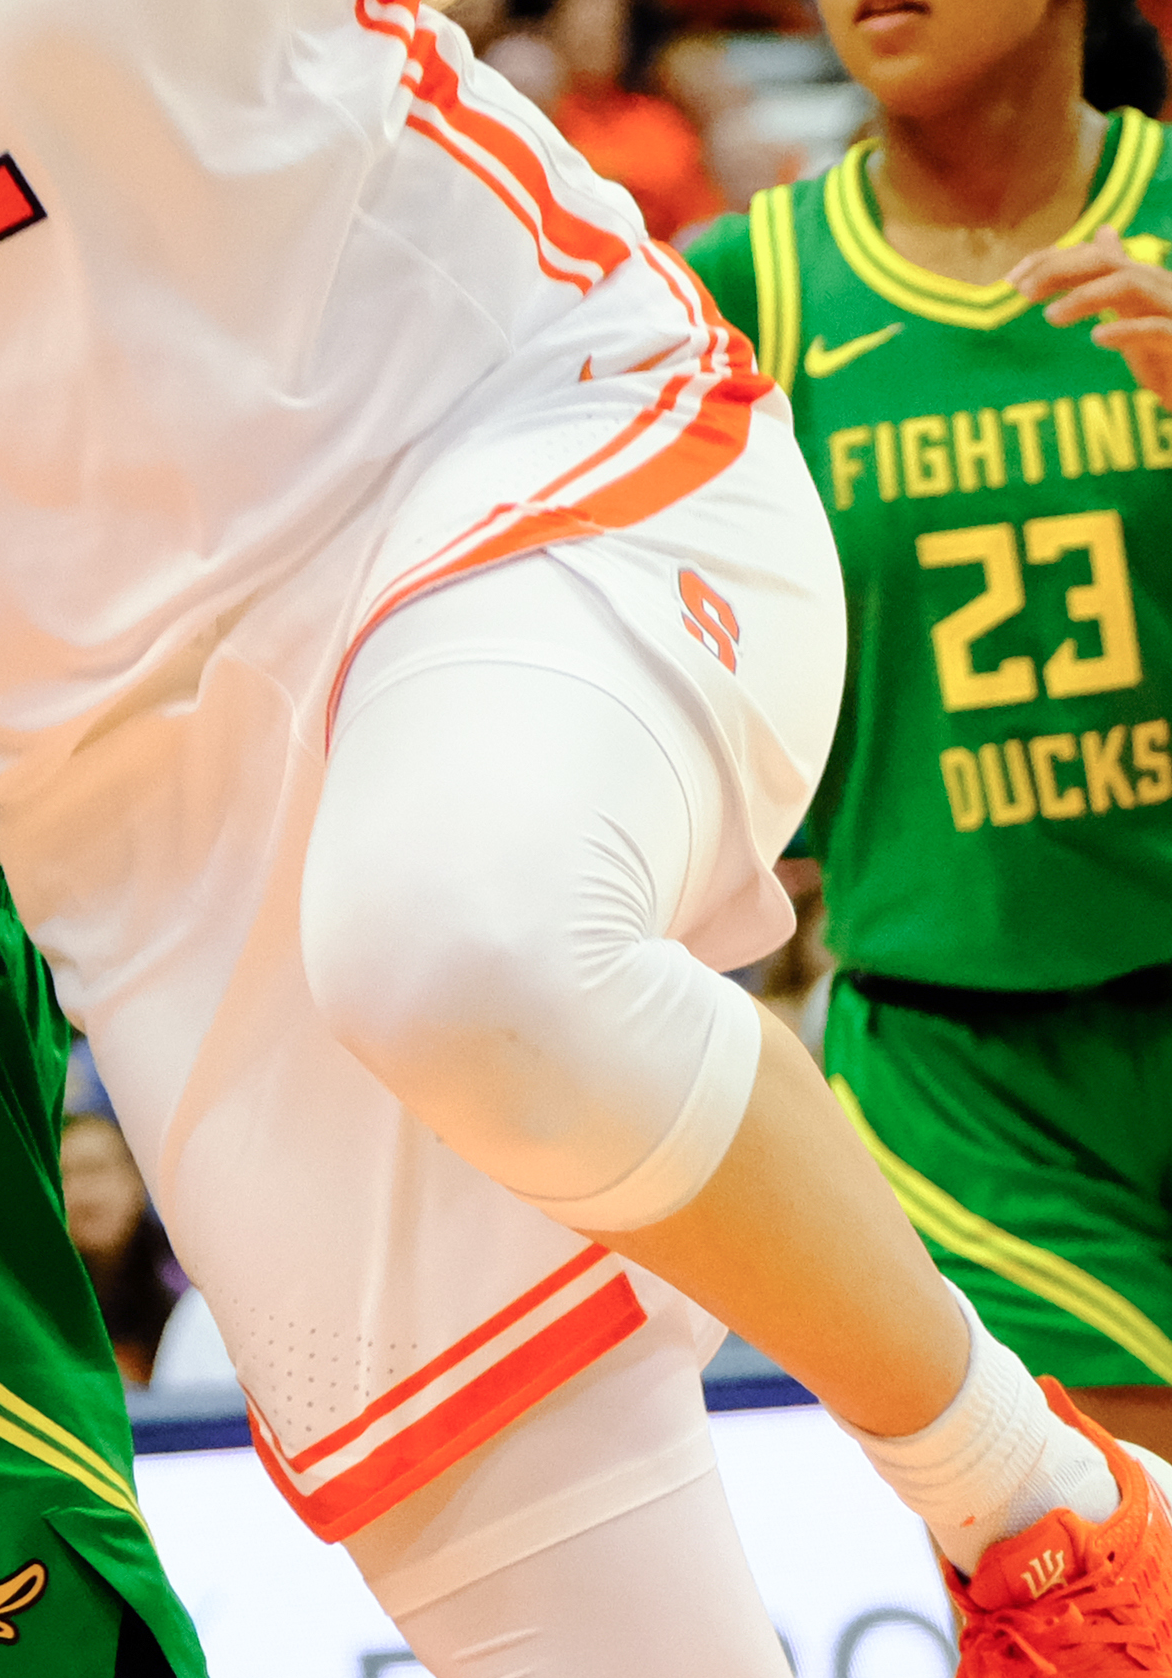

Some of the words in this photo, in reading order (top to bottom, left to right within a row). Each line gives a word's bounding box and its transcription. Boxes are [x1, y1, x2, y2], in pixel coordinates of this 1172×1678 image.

[828, 388, 1172, 511] FIGHTING
[914, 508, 1143, 713] 23
[939, 718, 1172, 833] DUCKS
